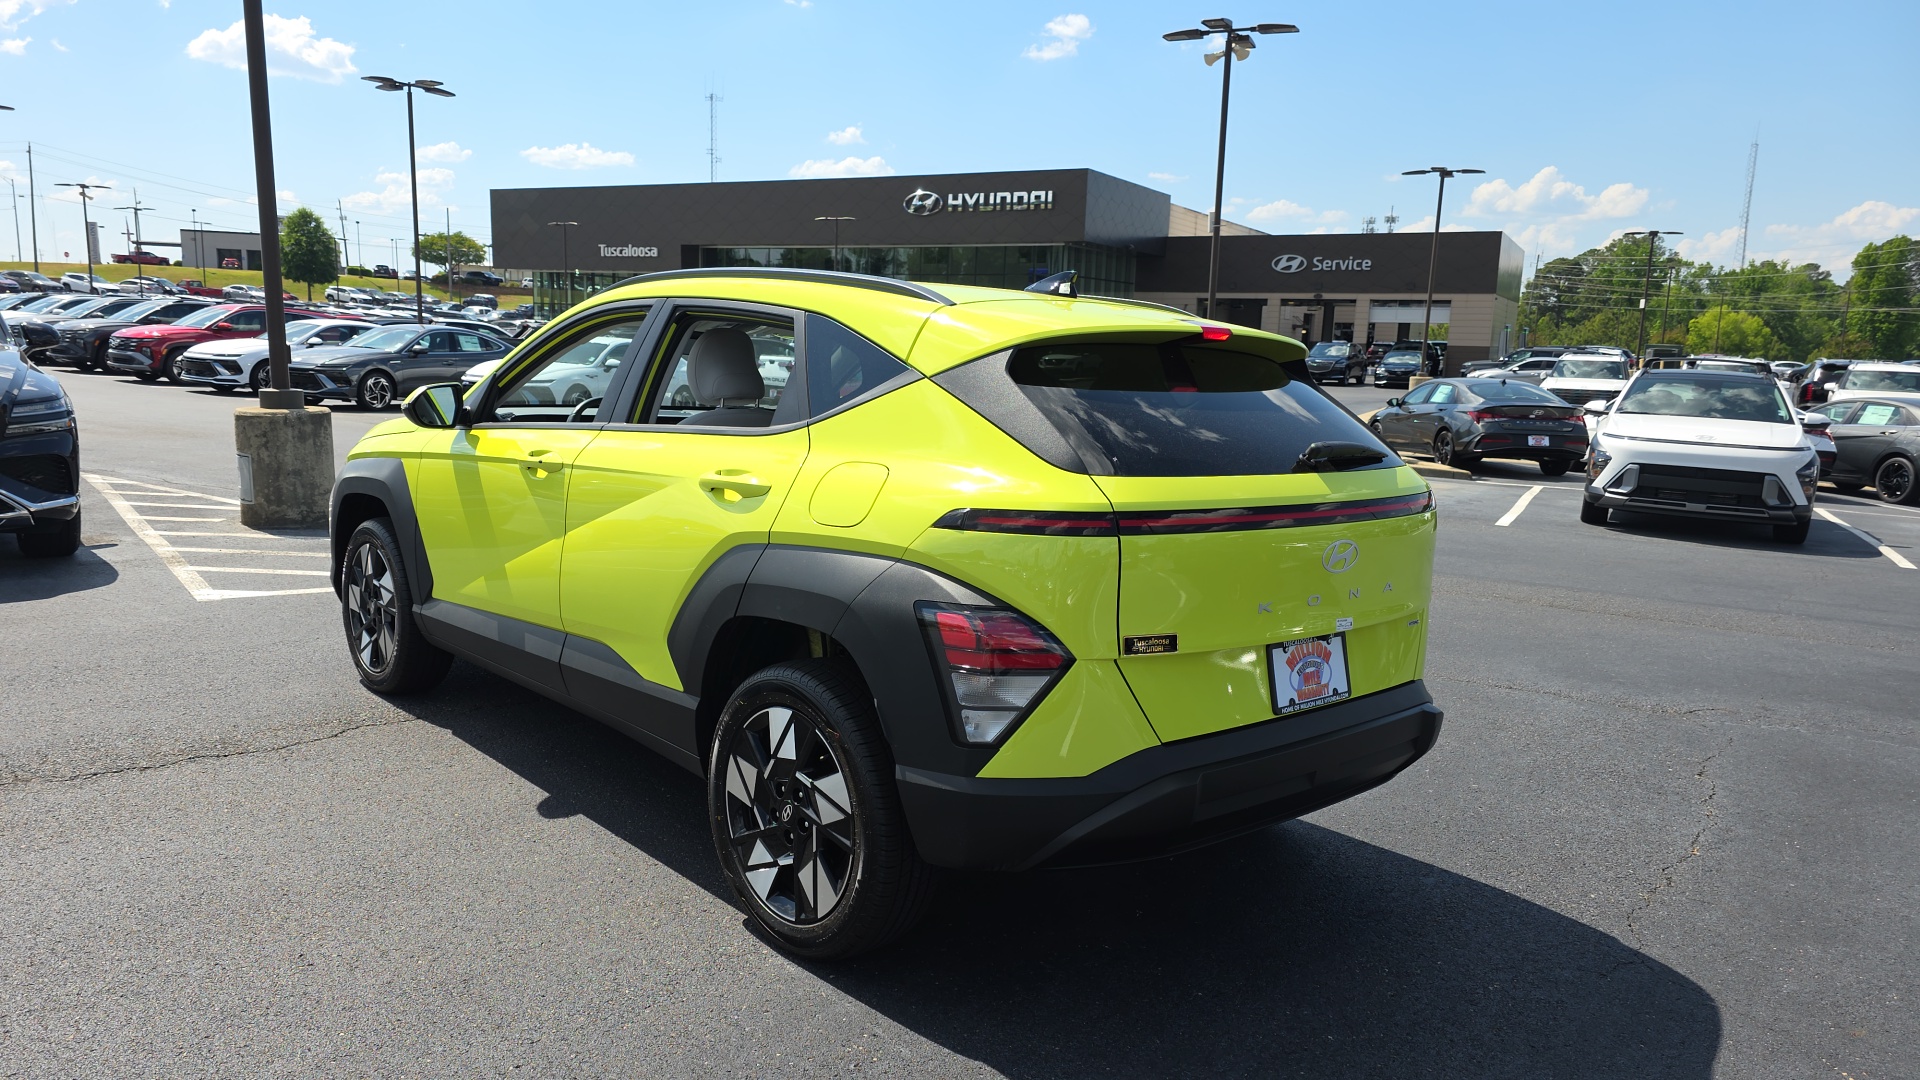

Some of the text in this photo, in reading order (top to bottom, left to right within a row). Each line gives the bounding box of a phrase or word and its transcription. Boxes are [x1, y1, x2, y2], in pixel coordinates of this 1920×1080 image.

[948, 191, 1053, 212] HYUNDAI
[598, 243, 658, 257] Tuscaloosa
[1311, 256, 1371, 270] Service
[1258, 582, 1393, 614] KONA
[1133, 638, 1170, 646] Tuscaloosa
[1286, 641, 1332, 672] MILLION
[1303, 669, 1321, 685] MILE
[1282, 706, 1294, 714] HOME
